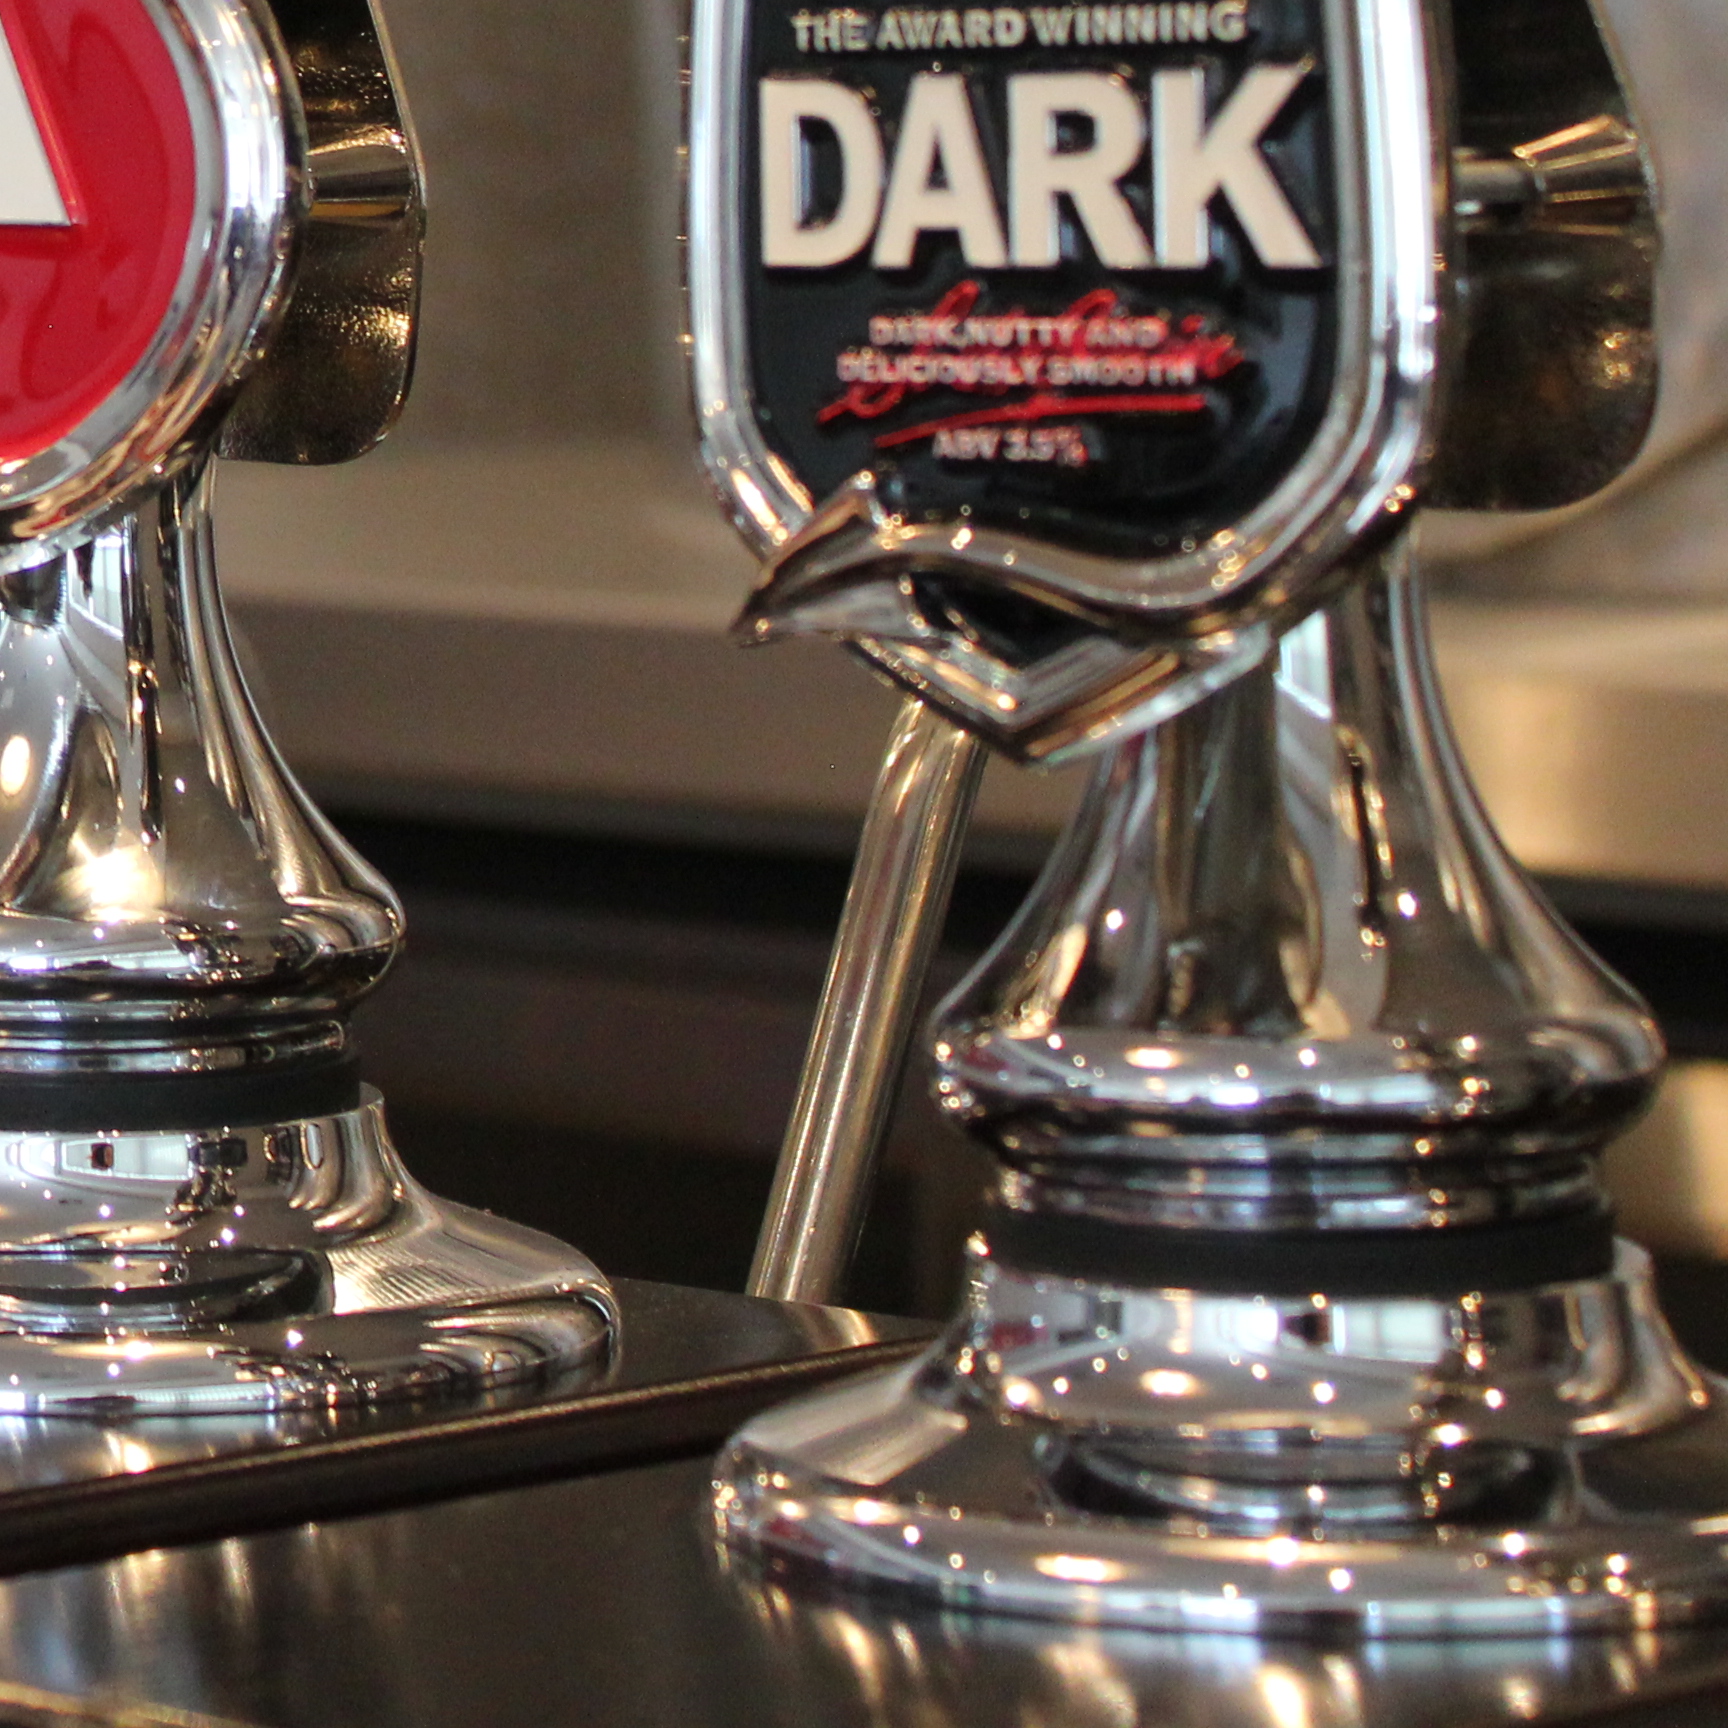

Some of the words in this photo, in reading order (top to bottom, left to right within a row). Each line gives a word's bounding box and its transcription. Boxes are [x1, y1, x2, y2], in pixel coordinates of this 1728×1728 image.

[791, 9, 870, 52] THE
[876, 7, 1027, 52] AWARD
[758, 62, 1324, 270] DARK
[1045, 354, 1197, 386] SMOOTH
